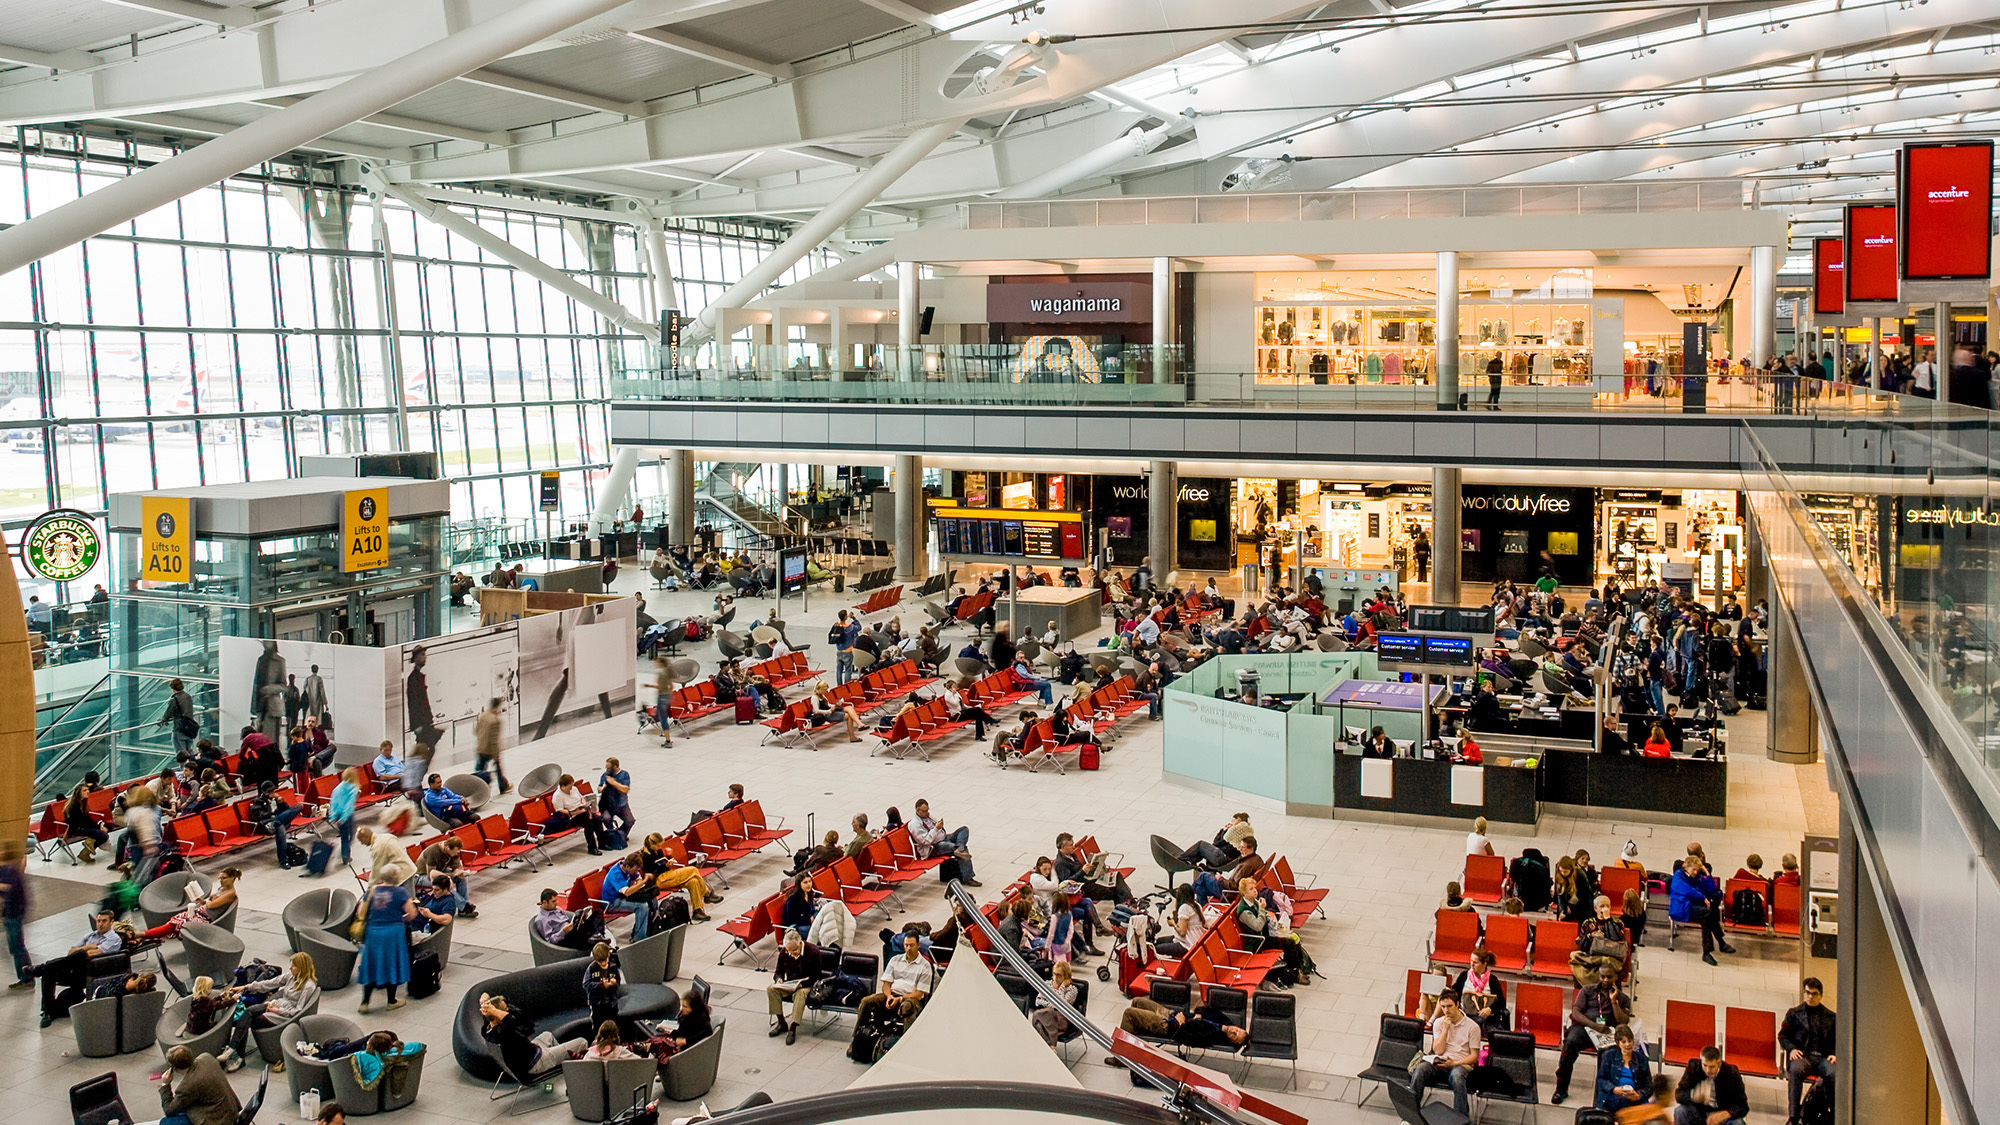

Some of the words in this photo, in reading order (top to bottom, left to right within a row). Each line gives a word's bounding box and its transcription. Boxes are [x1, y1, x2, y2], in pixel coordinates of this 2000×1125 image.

[1928, 186, 1970, 198] accenture
[1864, 235, 1894, 244] accenture
[1030, 298, 1121, 316] wagamama
[32, 520, 95, 548] STARBUCKS
[355, 526, 371, 535] Lifts
[372, 525, 381, 533] to
[151, 542, 170, 552] Lifts
[171, 543, 180, 553] to
[351, 535, 382, 556] A10
[39, 561, 88, 578] COFFEE
[149, 554, 182, 574] A10
